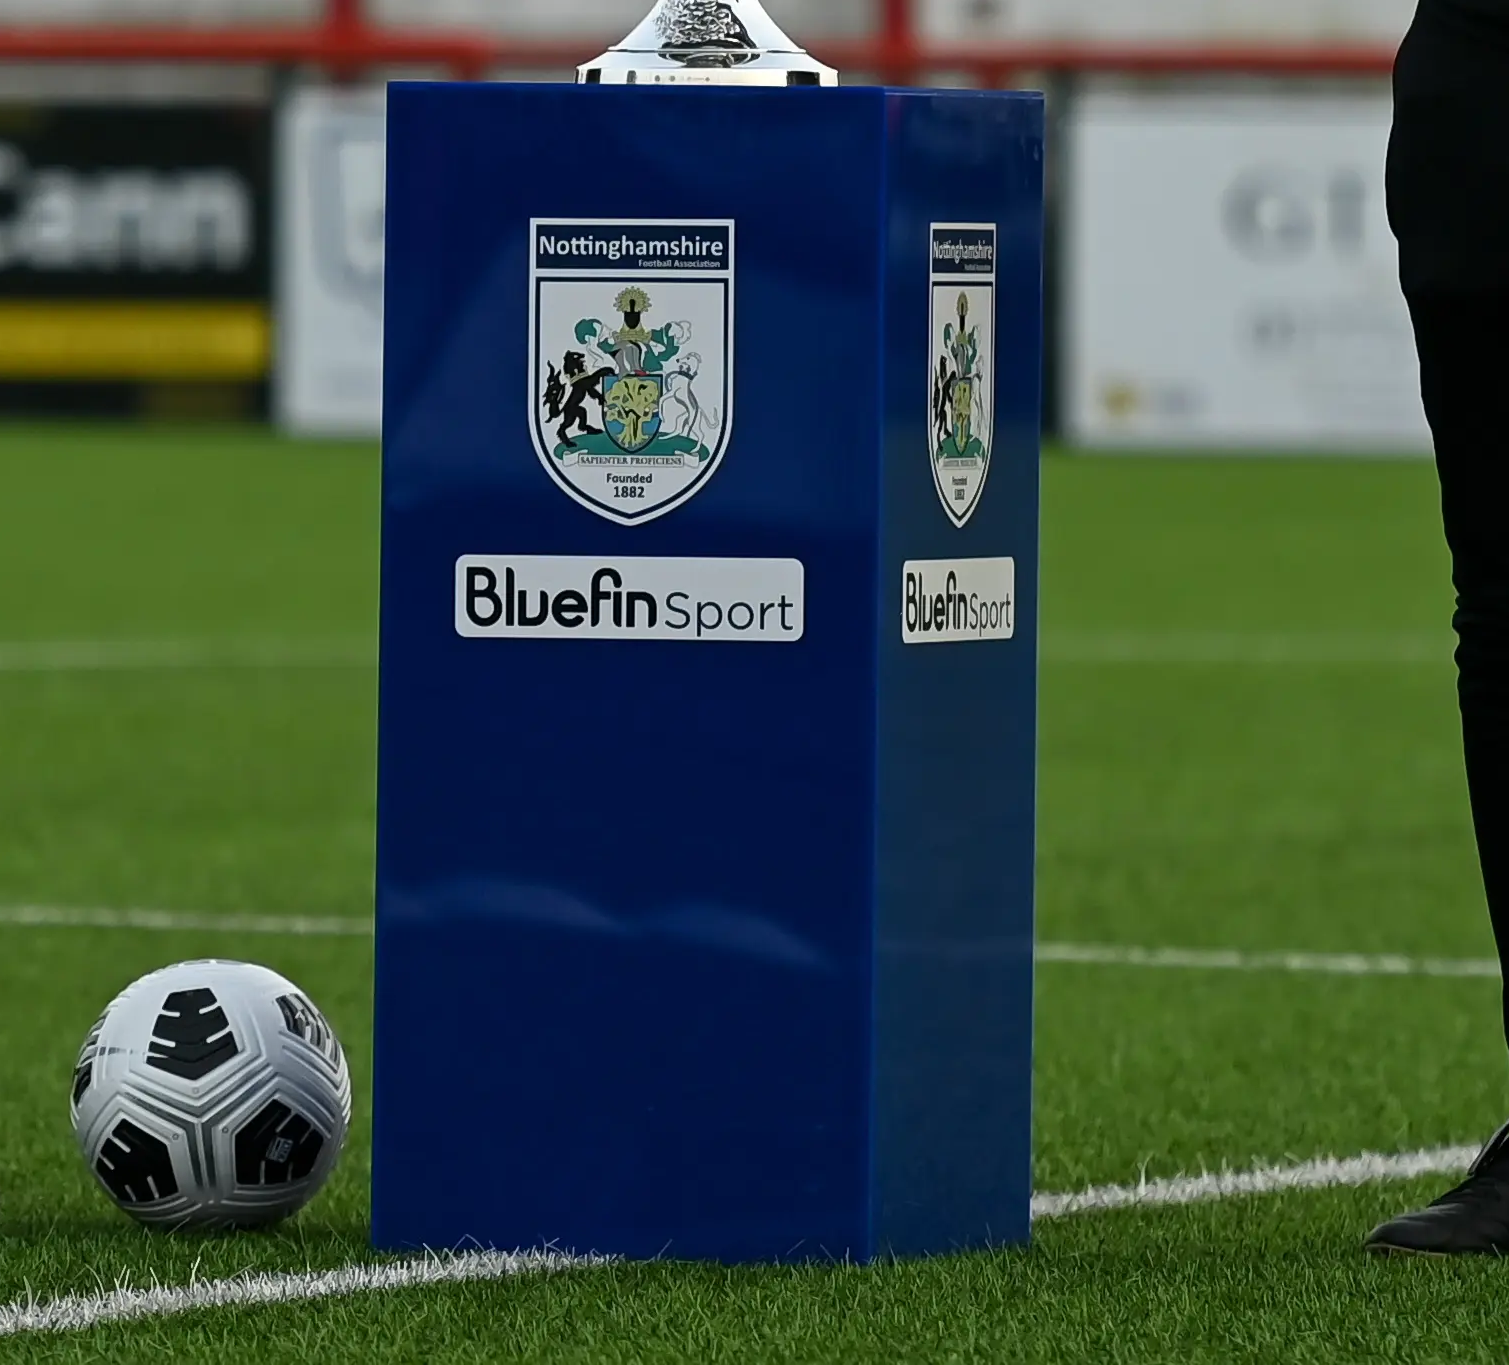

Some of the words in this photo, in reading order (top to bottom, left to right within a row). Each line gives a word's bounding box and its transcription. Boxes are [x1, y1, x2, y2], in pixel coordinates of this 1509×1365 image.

[539, 235, 724, 260] Nottinghamshire
[638, 259, 672, 268] Football
[673, 260, 721, 268] Association
[580, 456, 628, 465] SAPIENTER
[630, 457, 682, 466] PROFICIENS
[606, 473, 653, 484] Founded
[613, 486, 645, 498] 1882
